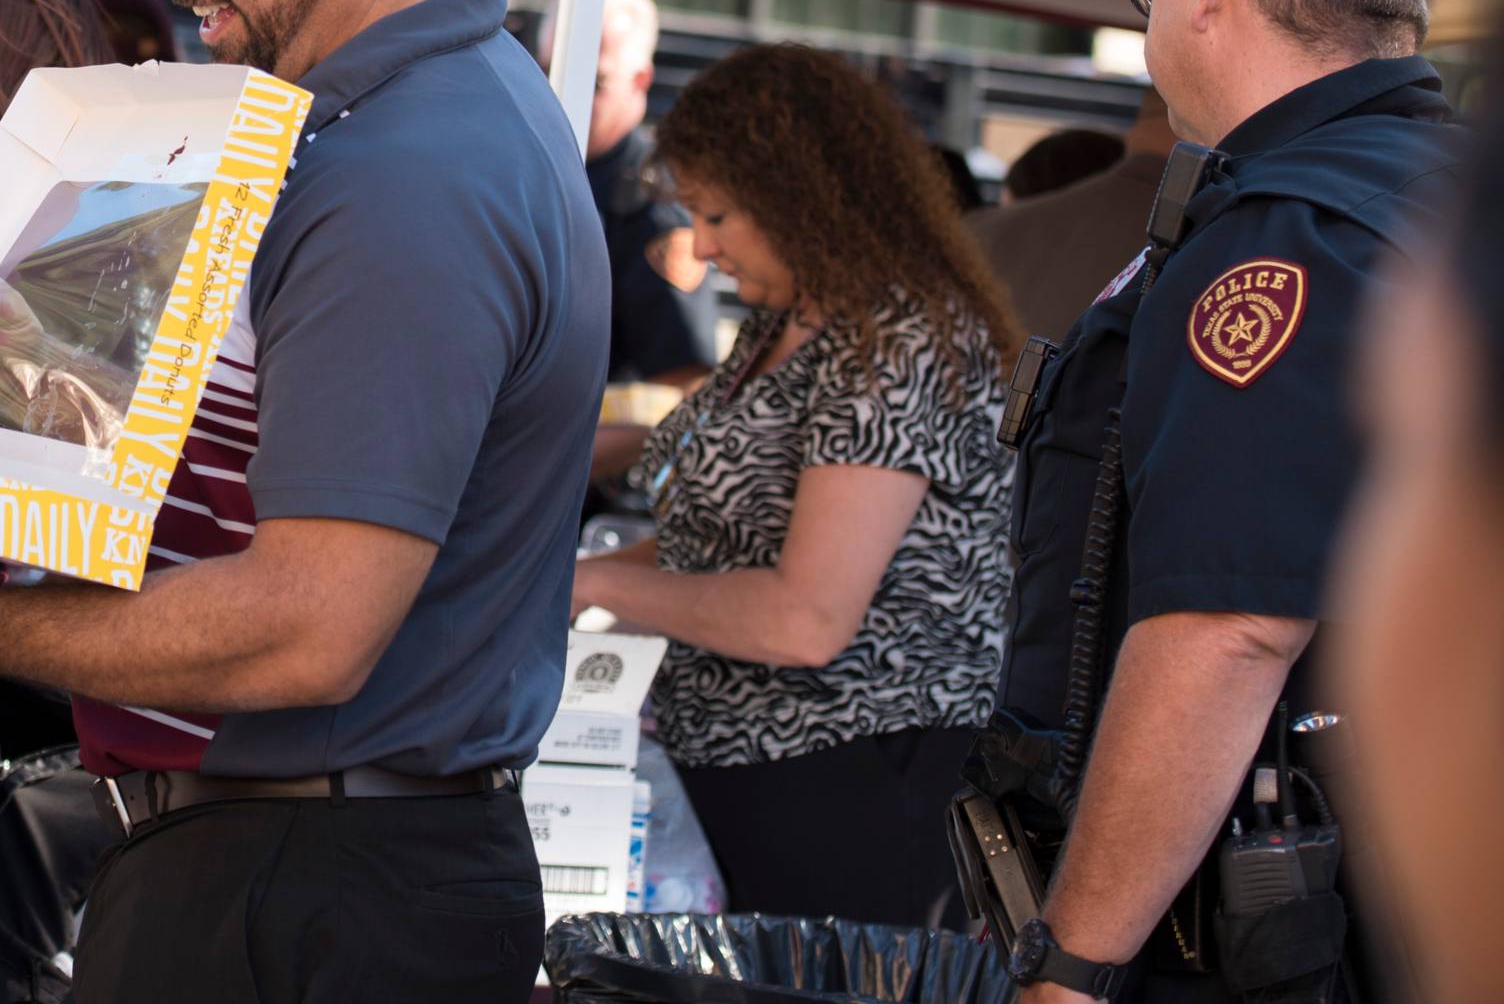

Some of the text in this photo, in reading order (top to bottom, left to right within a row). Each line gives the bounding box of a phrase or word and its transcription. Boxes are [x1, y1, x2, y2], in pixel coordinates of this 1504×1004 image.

[215, 73, 298, 203] DAILY
[234, 182, 250, 202] 12
[215, 205, 243, 254] Fresh
[185, 258, 223, 341] Assorted
[1201, 271, 1289, 314] POLICE
[119, 334, 203, 459] DAILY
[160, 343, 193, 407] Donuts
